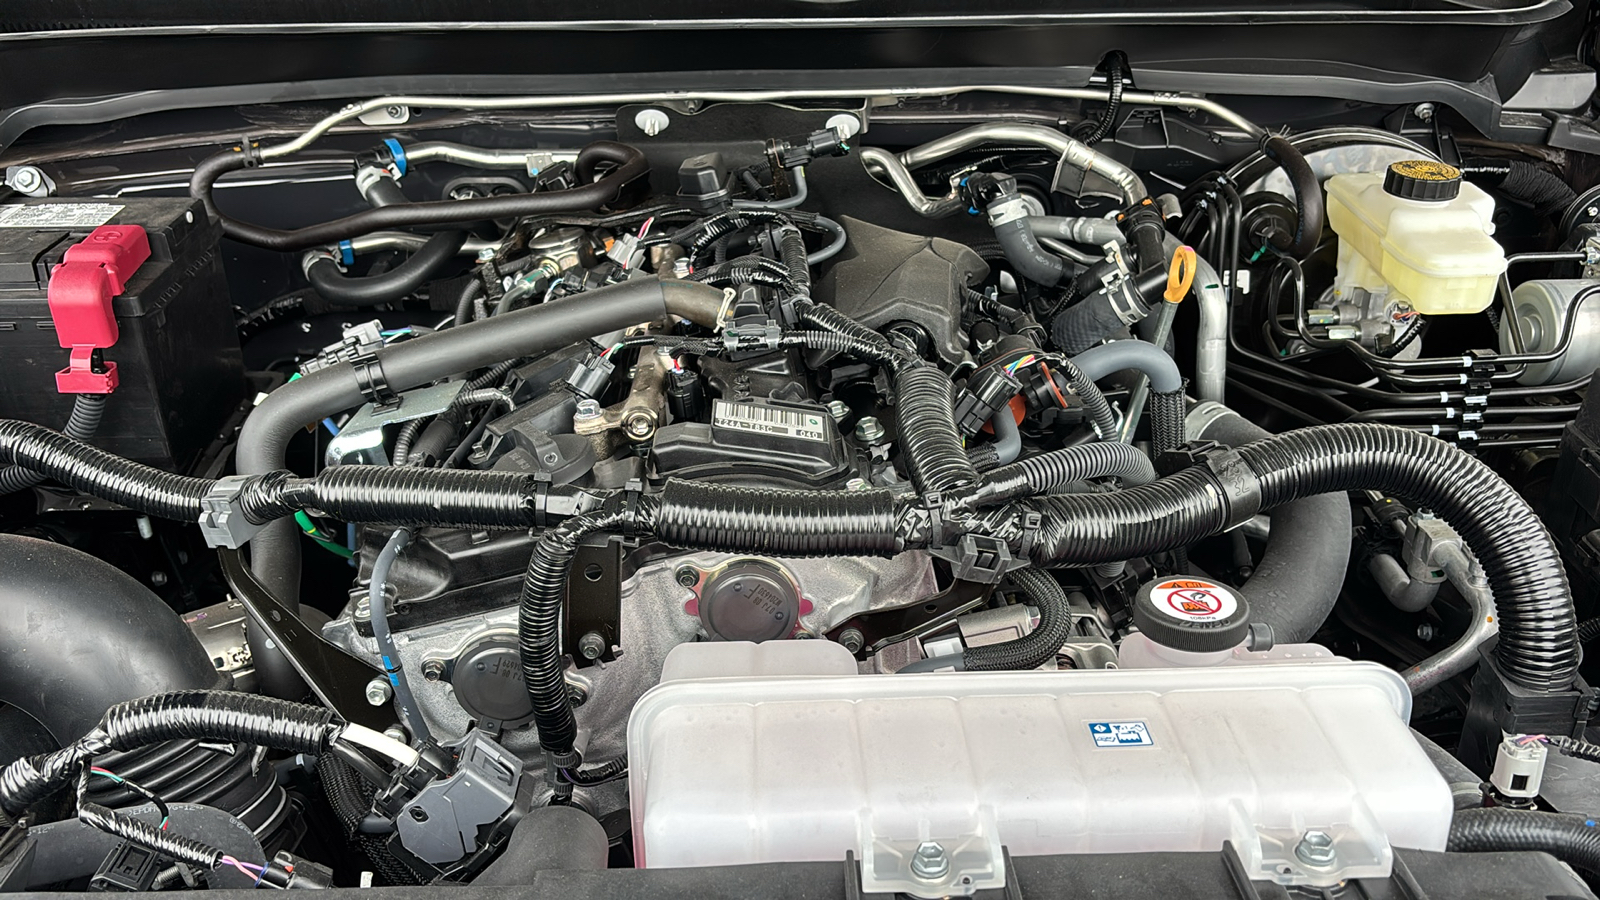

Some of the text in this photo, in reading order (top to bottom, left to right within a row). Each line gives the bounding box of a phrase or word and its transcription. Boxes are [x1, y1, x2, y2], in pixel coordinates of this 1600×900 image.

[799, 430, 818, 439] 040
[743, 583, 760, 599] F
[489, 656, 502, 675] F
